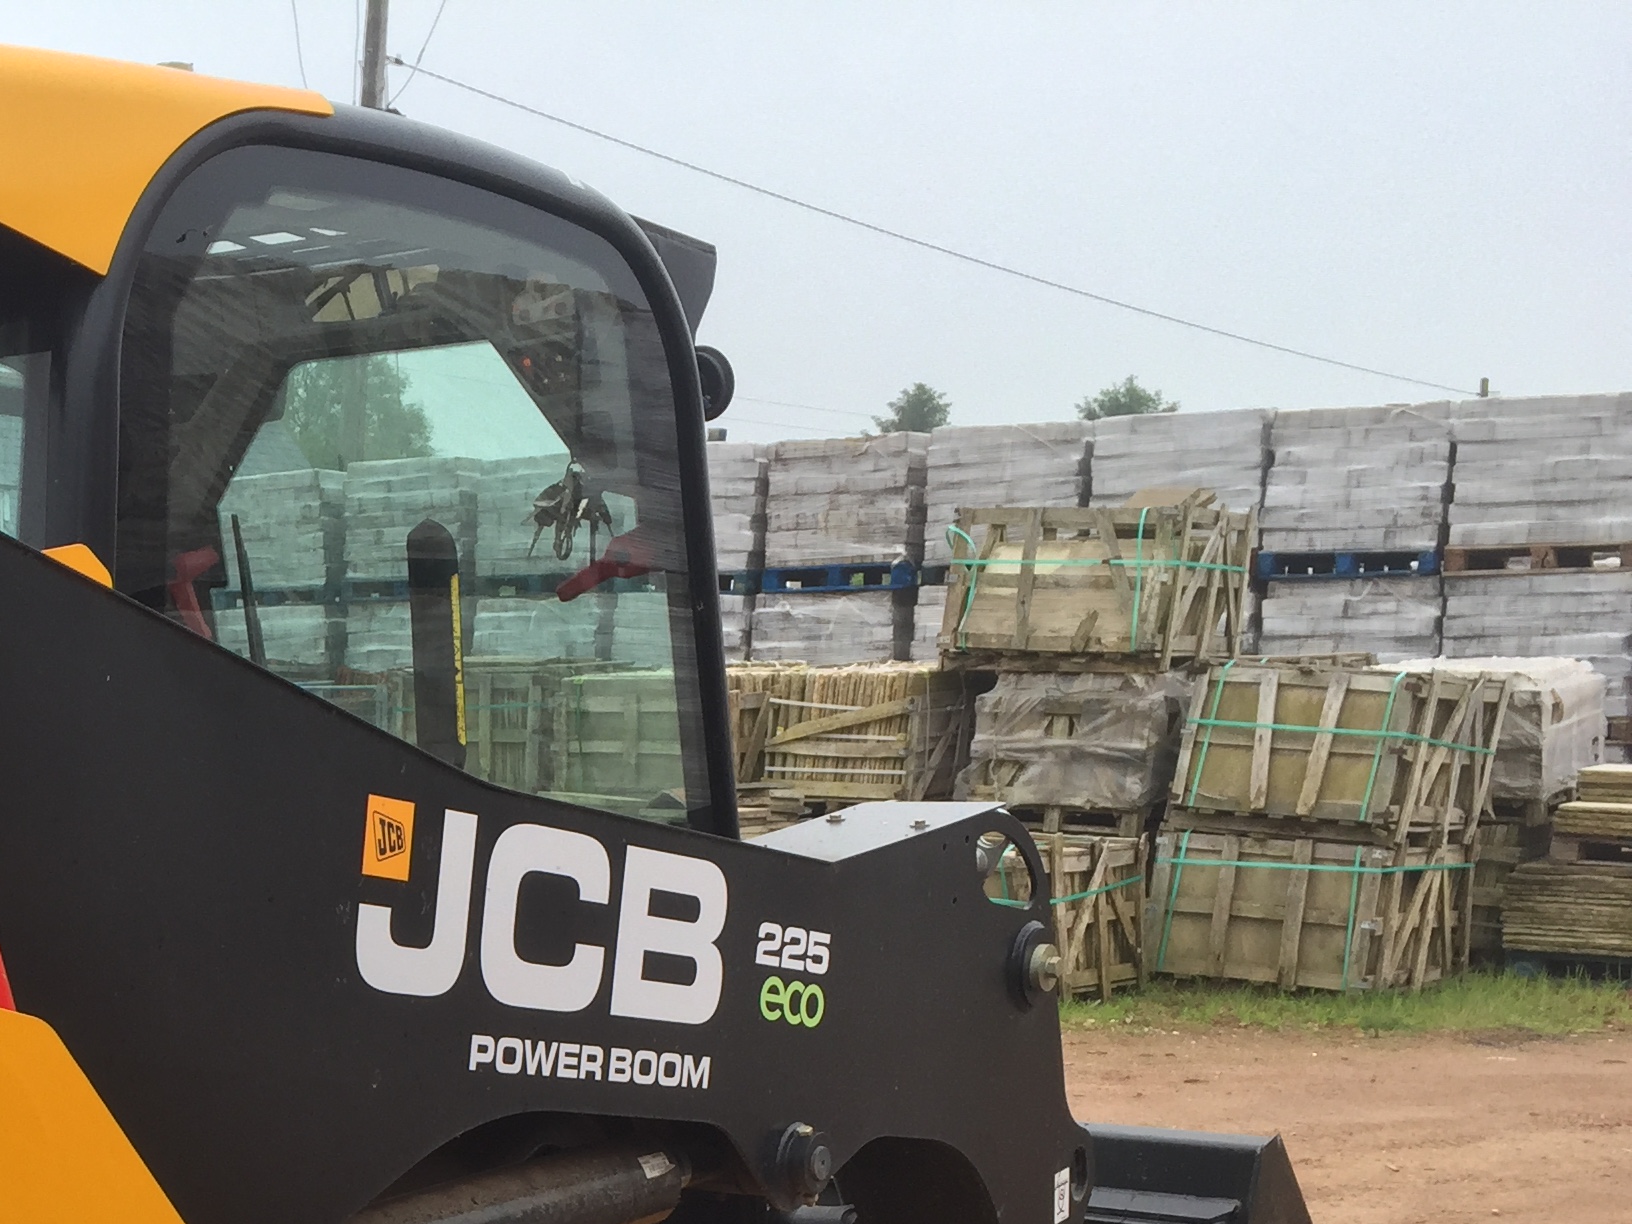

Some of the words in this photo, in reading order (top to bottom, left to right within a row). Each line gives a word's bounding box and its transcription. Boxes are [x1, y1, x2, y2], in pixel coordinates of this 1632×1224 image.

[377, 817, 404, 856] JCB
[355, 808, 728, 1025] JCB
[755, 921, 832, 975] 225
[759, 975, 825, 1028] eco
[468, 1034, 604, 1081] POWER
[608, 1047, 711, 1089] BOOM
